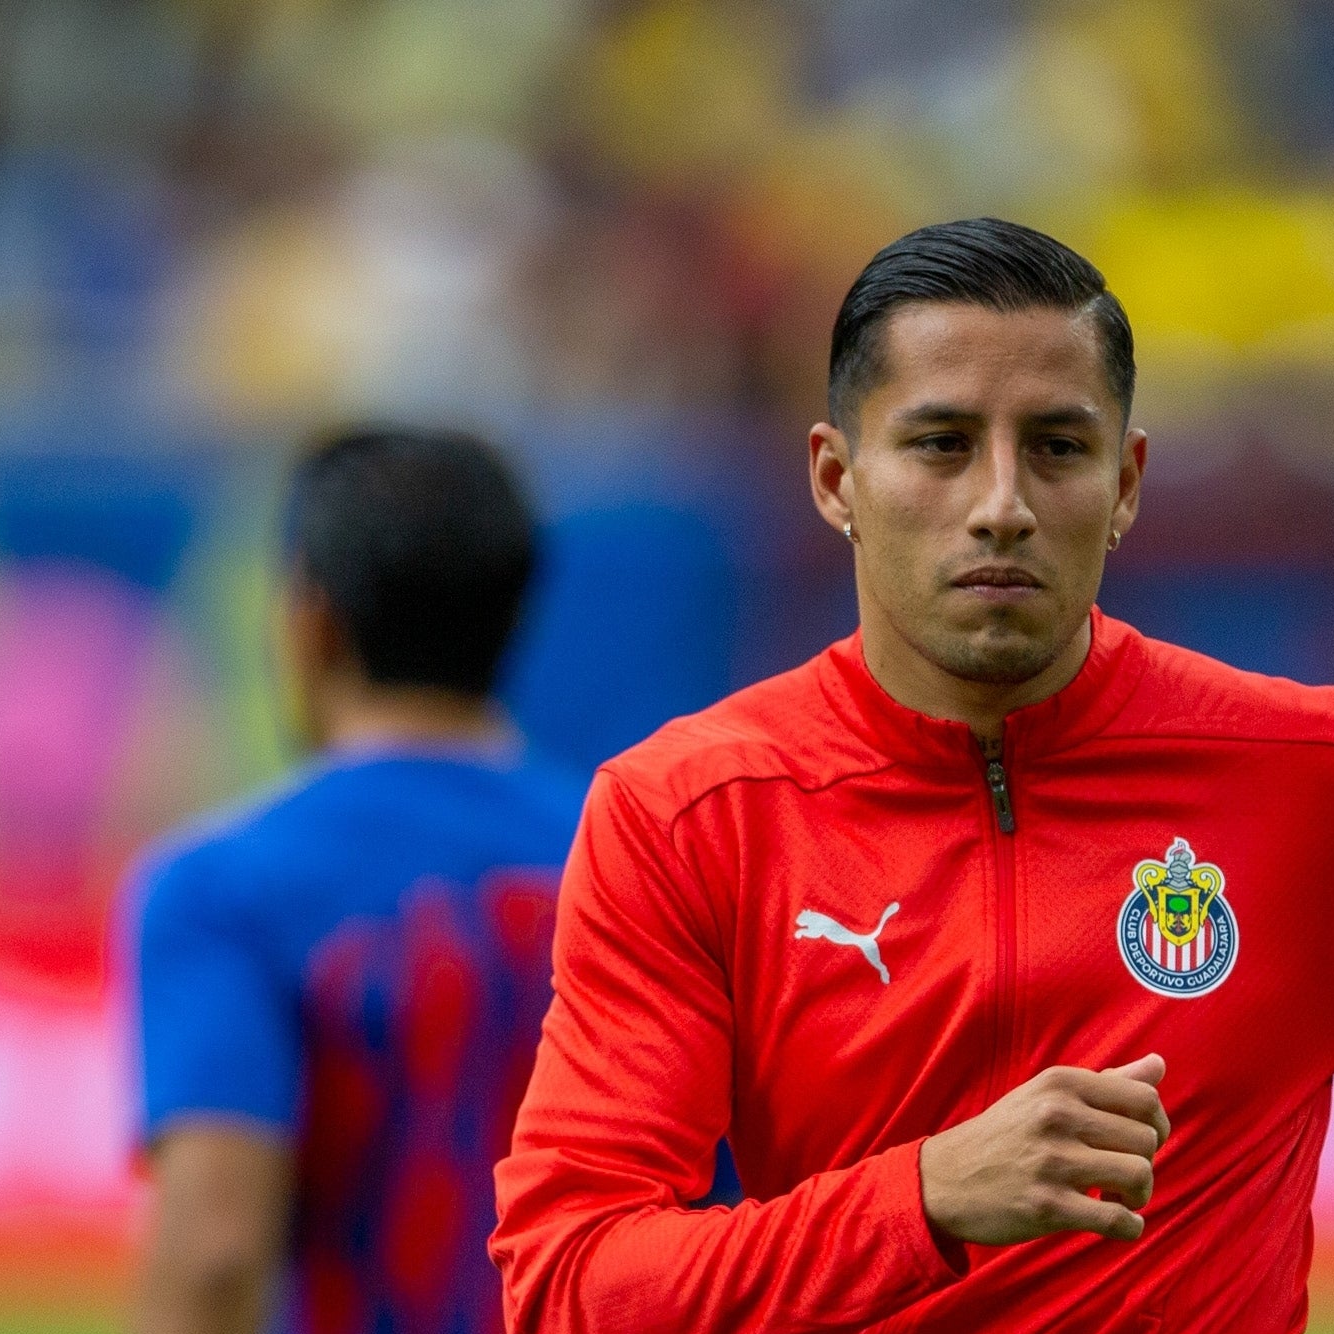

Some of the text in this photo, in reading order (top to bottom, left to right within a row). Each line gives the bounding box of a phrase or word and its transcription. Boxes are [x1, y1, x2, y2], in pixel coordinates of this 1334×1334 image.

[1127, 908, 1229, 988] CLUB DEPORTIVO GUADALAJARA
